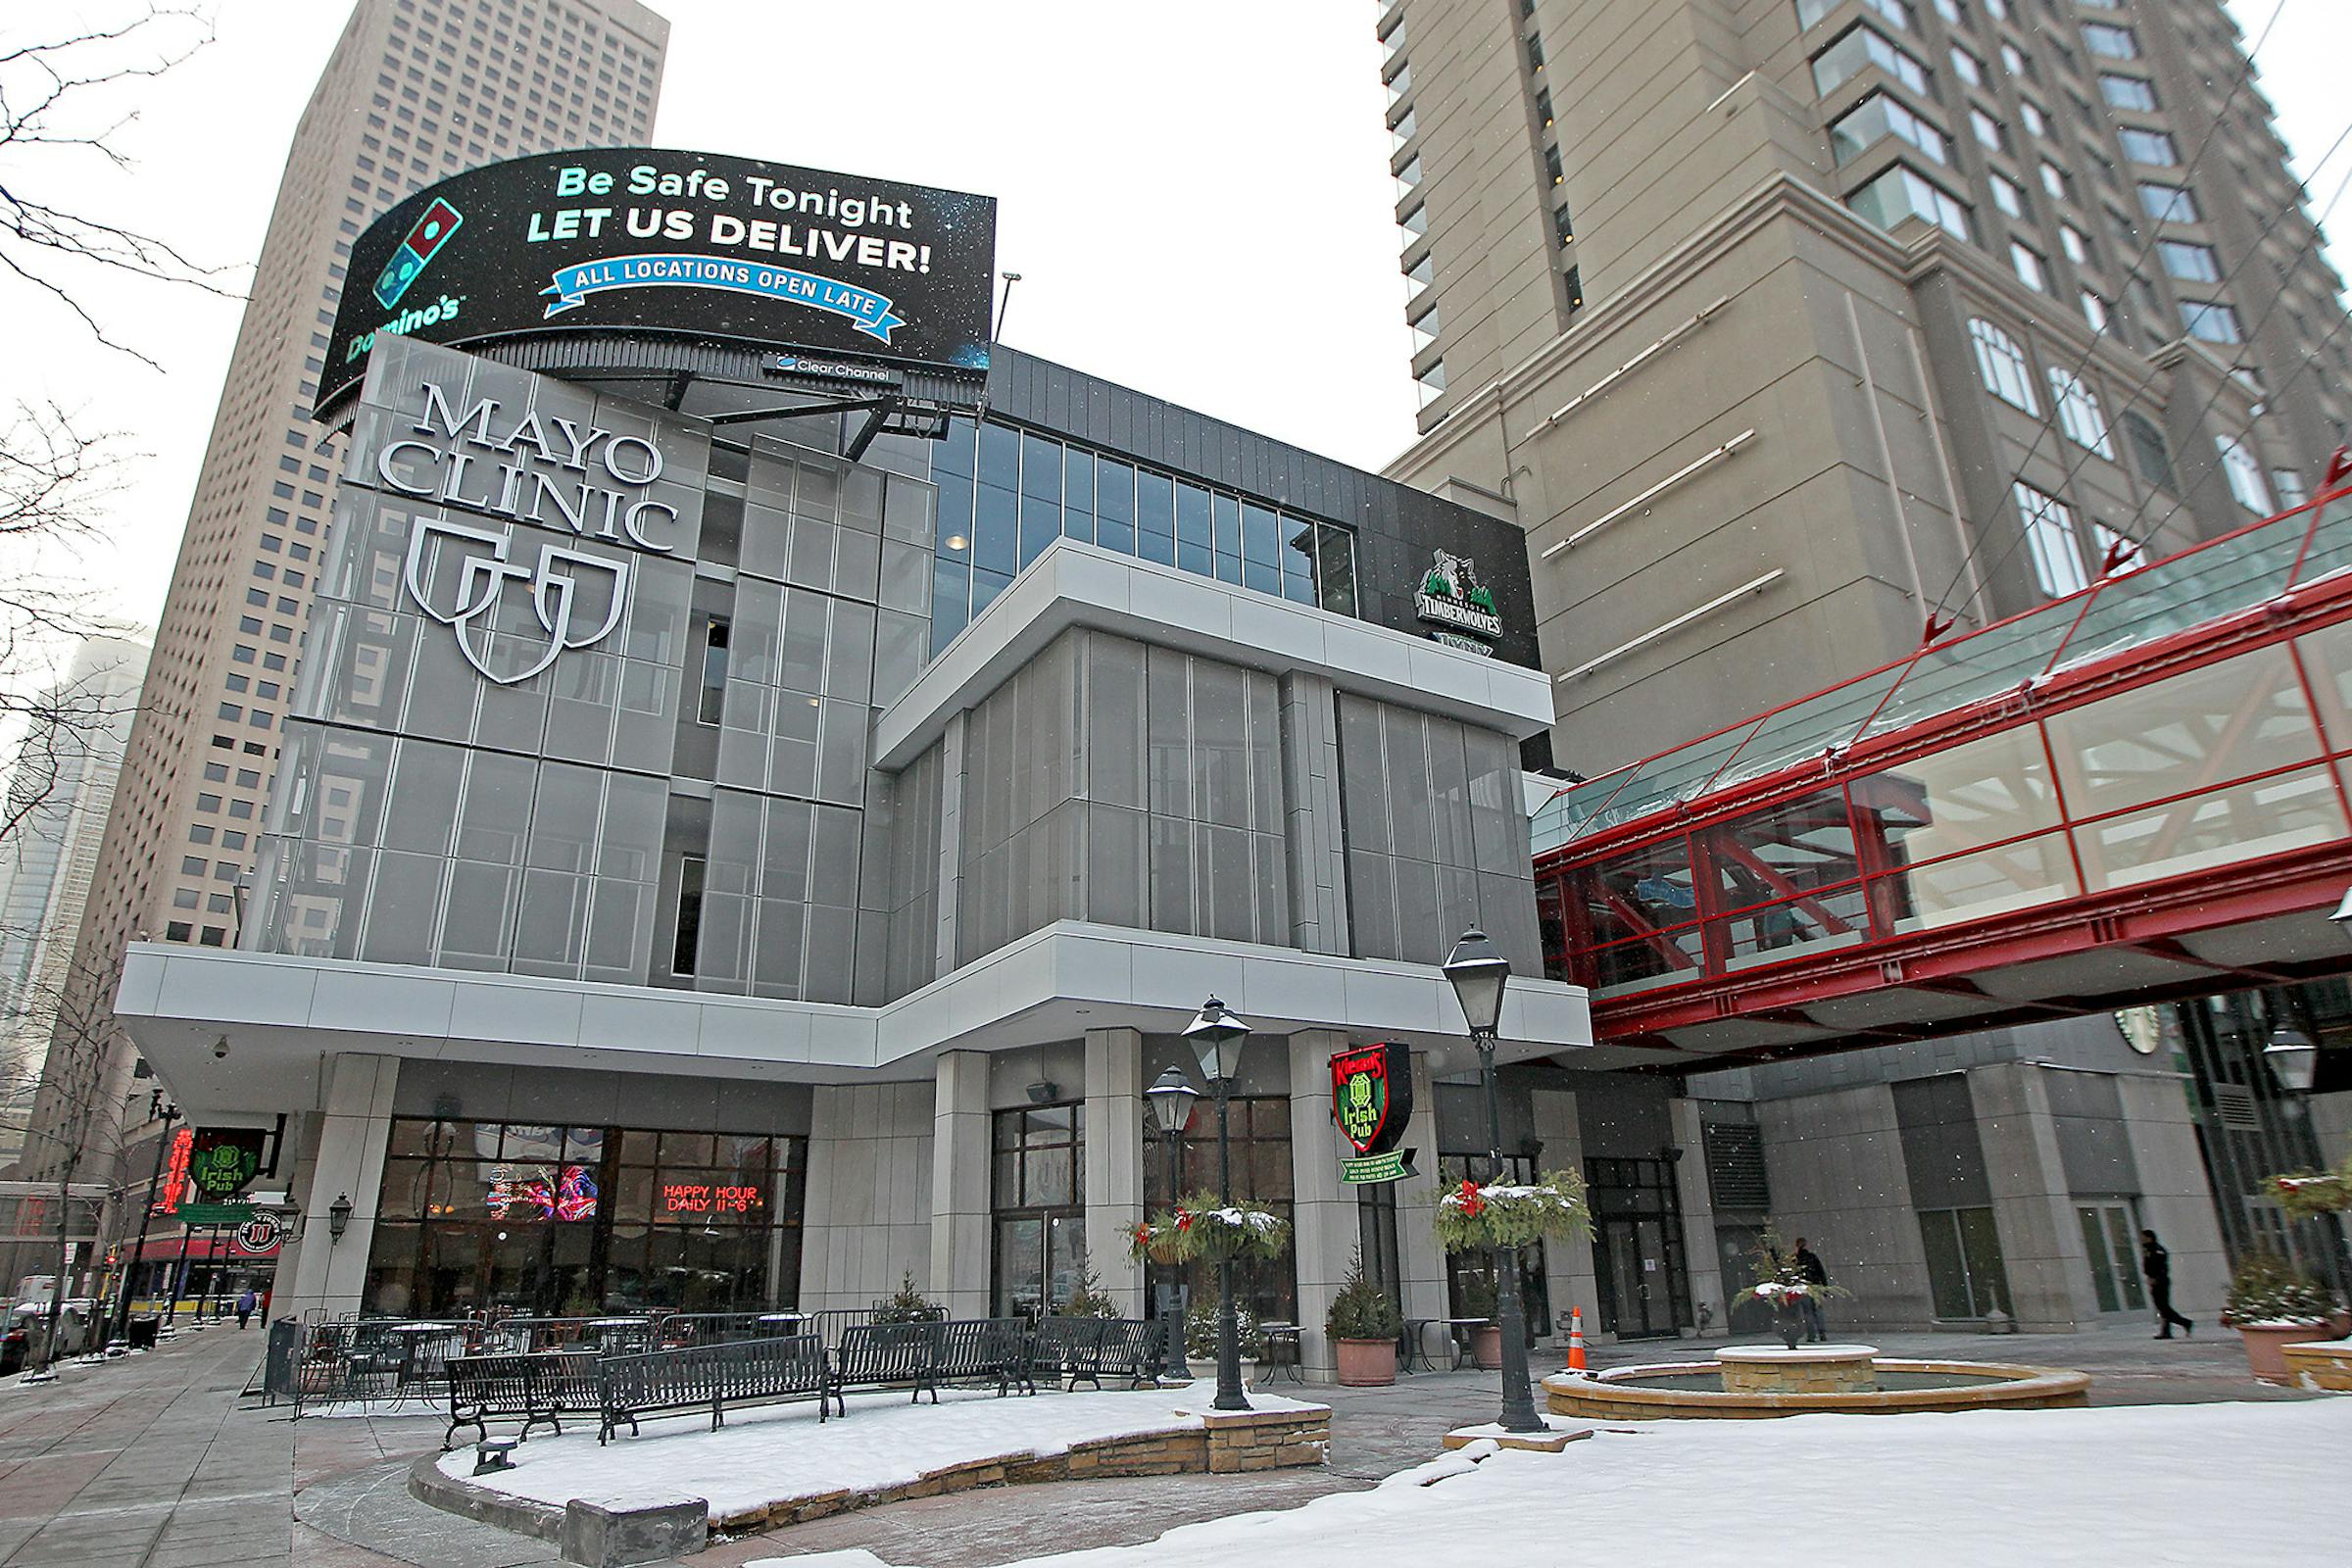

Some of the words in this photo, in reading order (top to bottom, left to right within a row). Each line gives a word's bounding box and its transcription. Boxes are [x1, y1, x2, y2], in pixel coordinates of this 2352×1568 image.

[557, 166, 614, 197] Be
[627, 165, 730, 201] Safe
[746, 175, 912, 229] Tonight
[527, 208, 612, 243] LET
[626, 208, 695, 241] US
[710, 215, 932, 274] DELIVER!
[575, 266, 615, 288] ALL
[624, 261, 750, 283] LOCATIONS
[758, 270, 817, 298] OPEN
[823, 285, 877, 316] LATE
[797, 360, 833, 373] Clear
[835, 365, 889, 381] Channel
[412, 381, 664, 485] MAYO
[377, 441, 679, 552] CLINIC
[1421, 593, 1501, 635] TIMBERWOLVES
[1344, 1102, 1377, 1126] Irish
[1350, 1121, 1372, 1139] Pub
[201, 1166, 244, 1181] Irish
[206, 1180, 234, 1192] Pub
[663, 1185, 710, 1199] HAPPY
[715, 1186, 758, 1200] HOUR
[667, 1198, 711, 1211] DAILY
[249, 1223, 271, 1243] JJ
